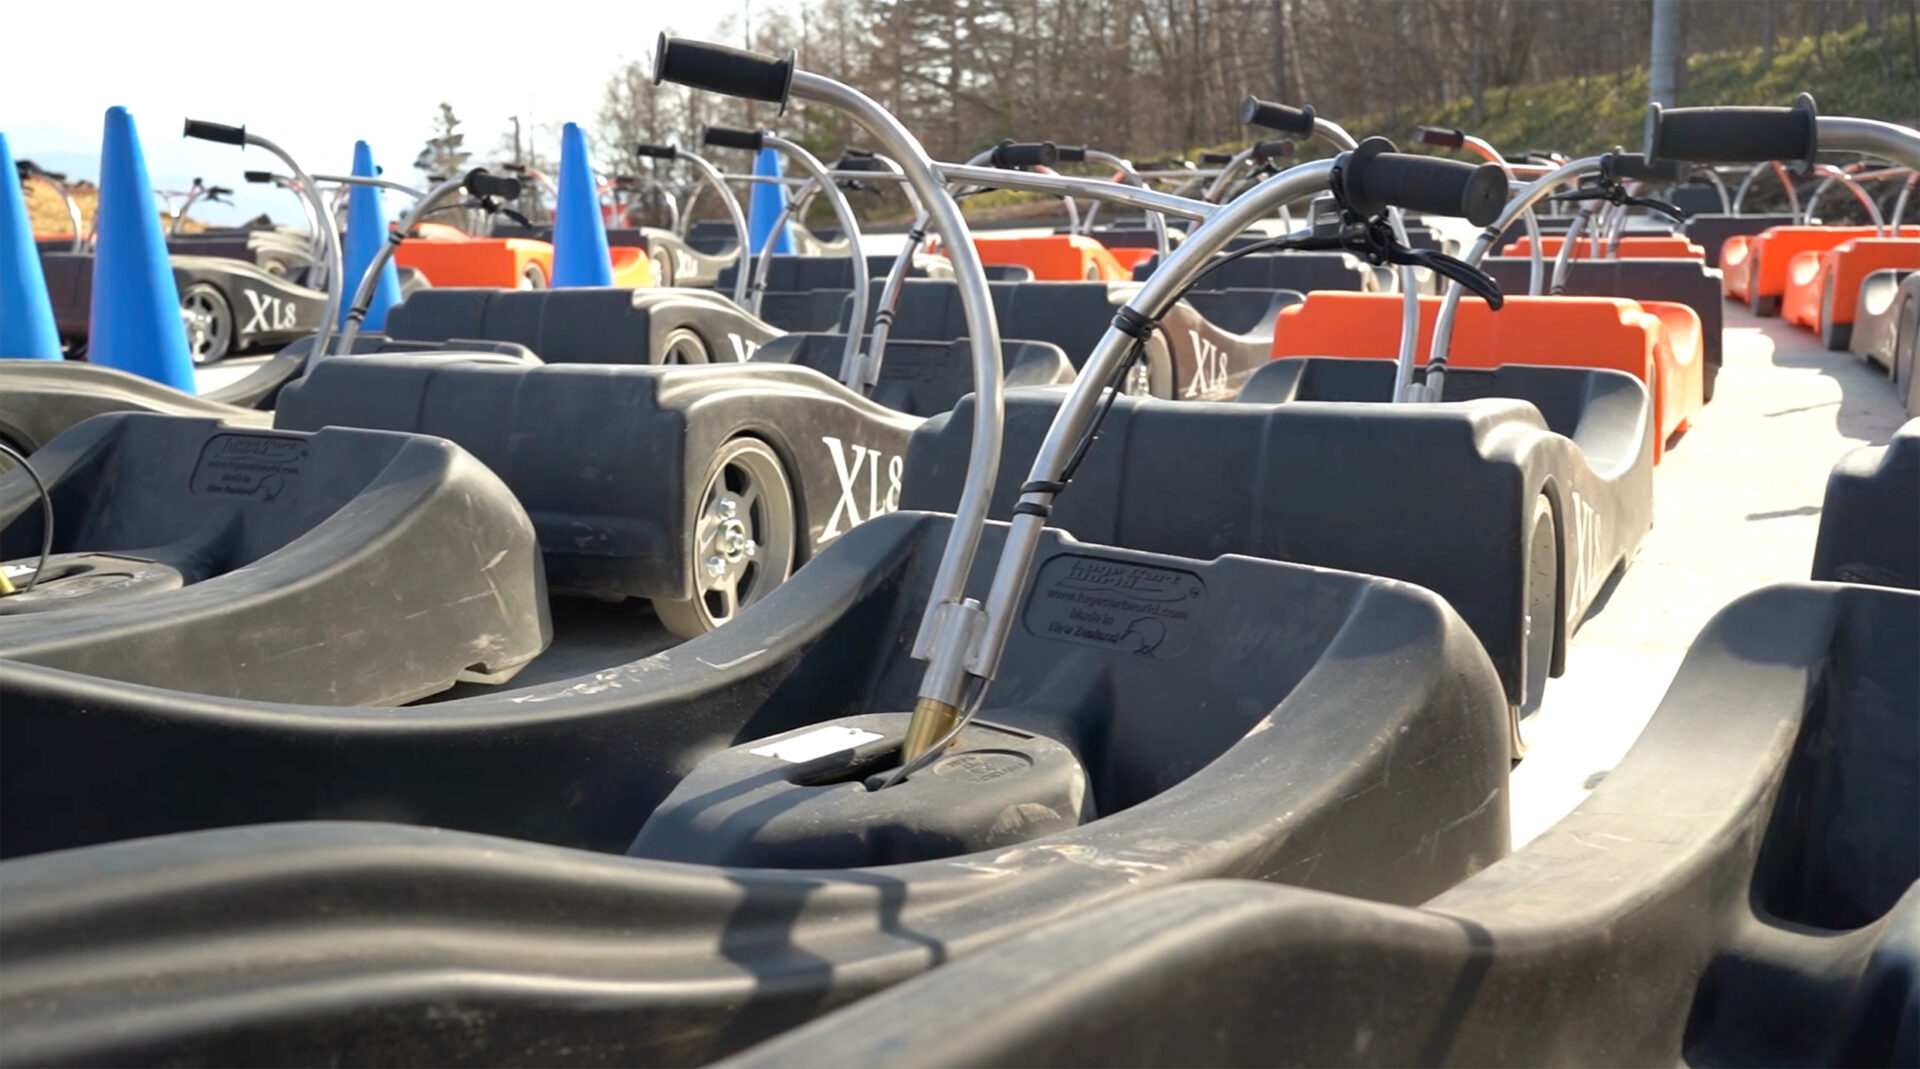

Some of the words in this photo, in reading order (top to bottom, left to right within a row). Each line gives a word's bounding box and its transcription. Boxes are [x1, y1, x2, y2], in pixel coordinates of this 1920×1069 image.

[241, 288, 296, 334] XL8
[1185, 330, 1228, 398] XL8
[816, 436, 903, 544] XL8
